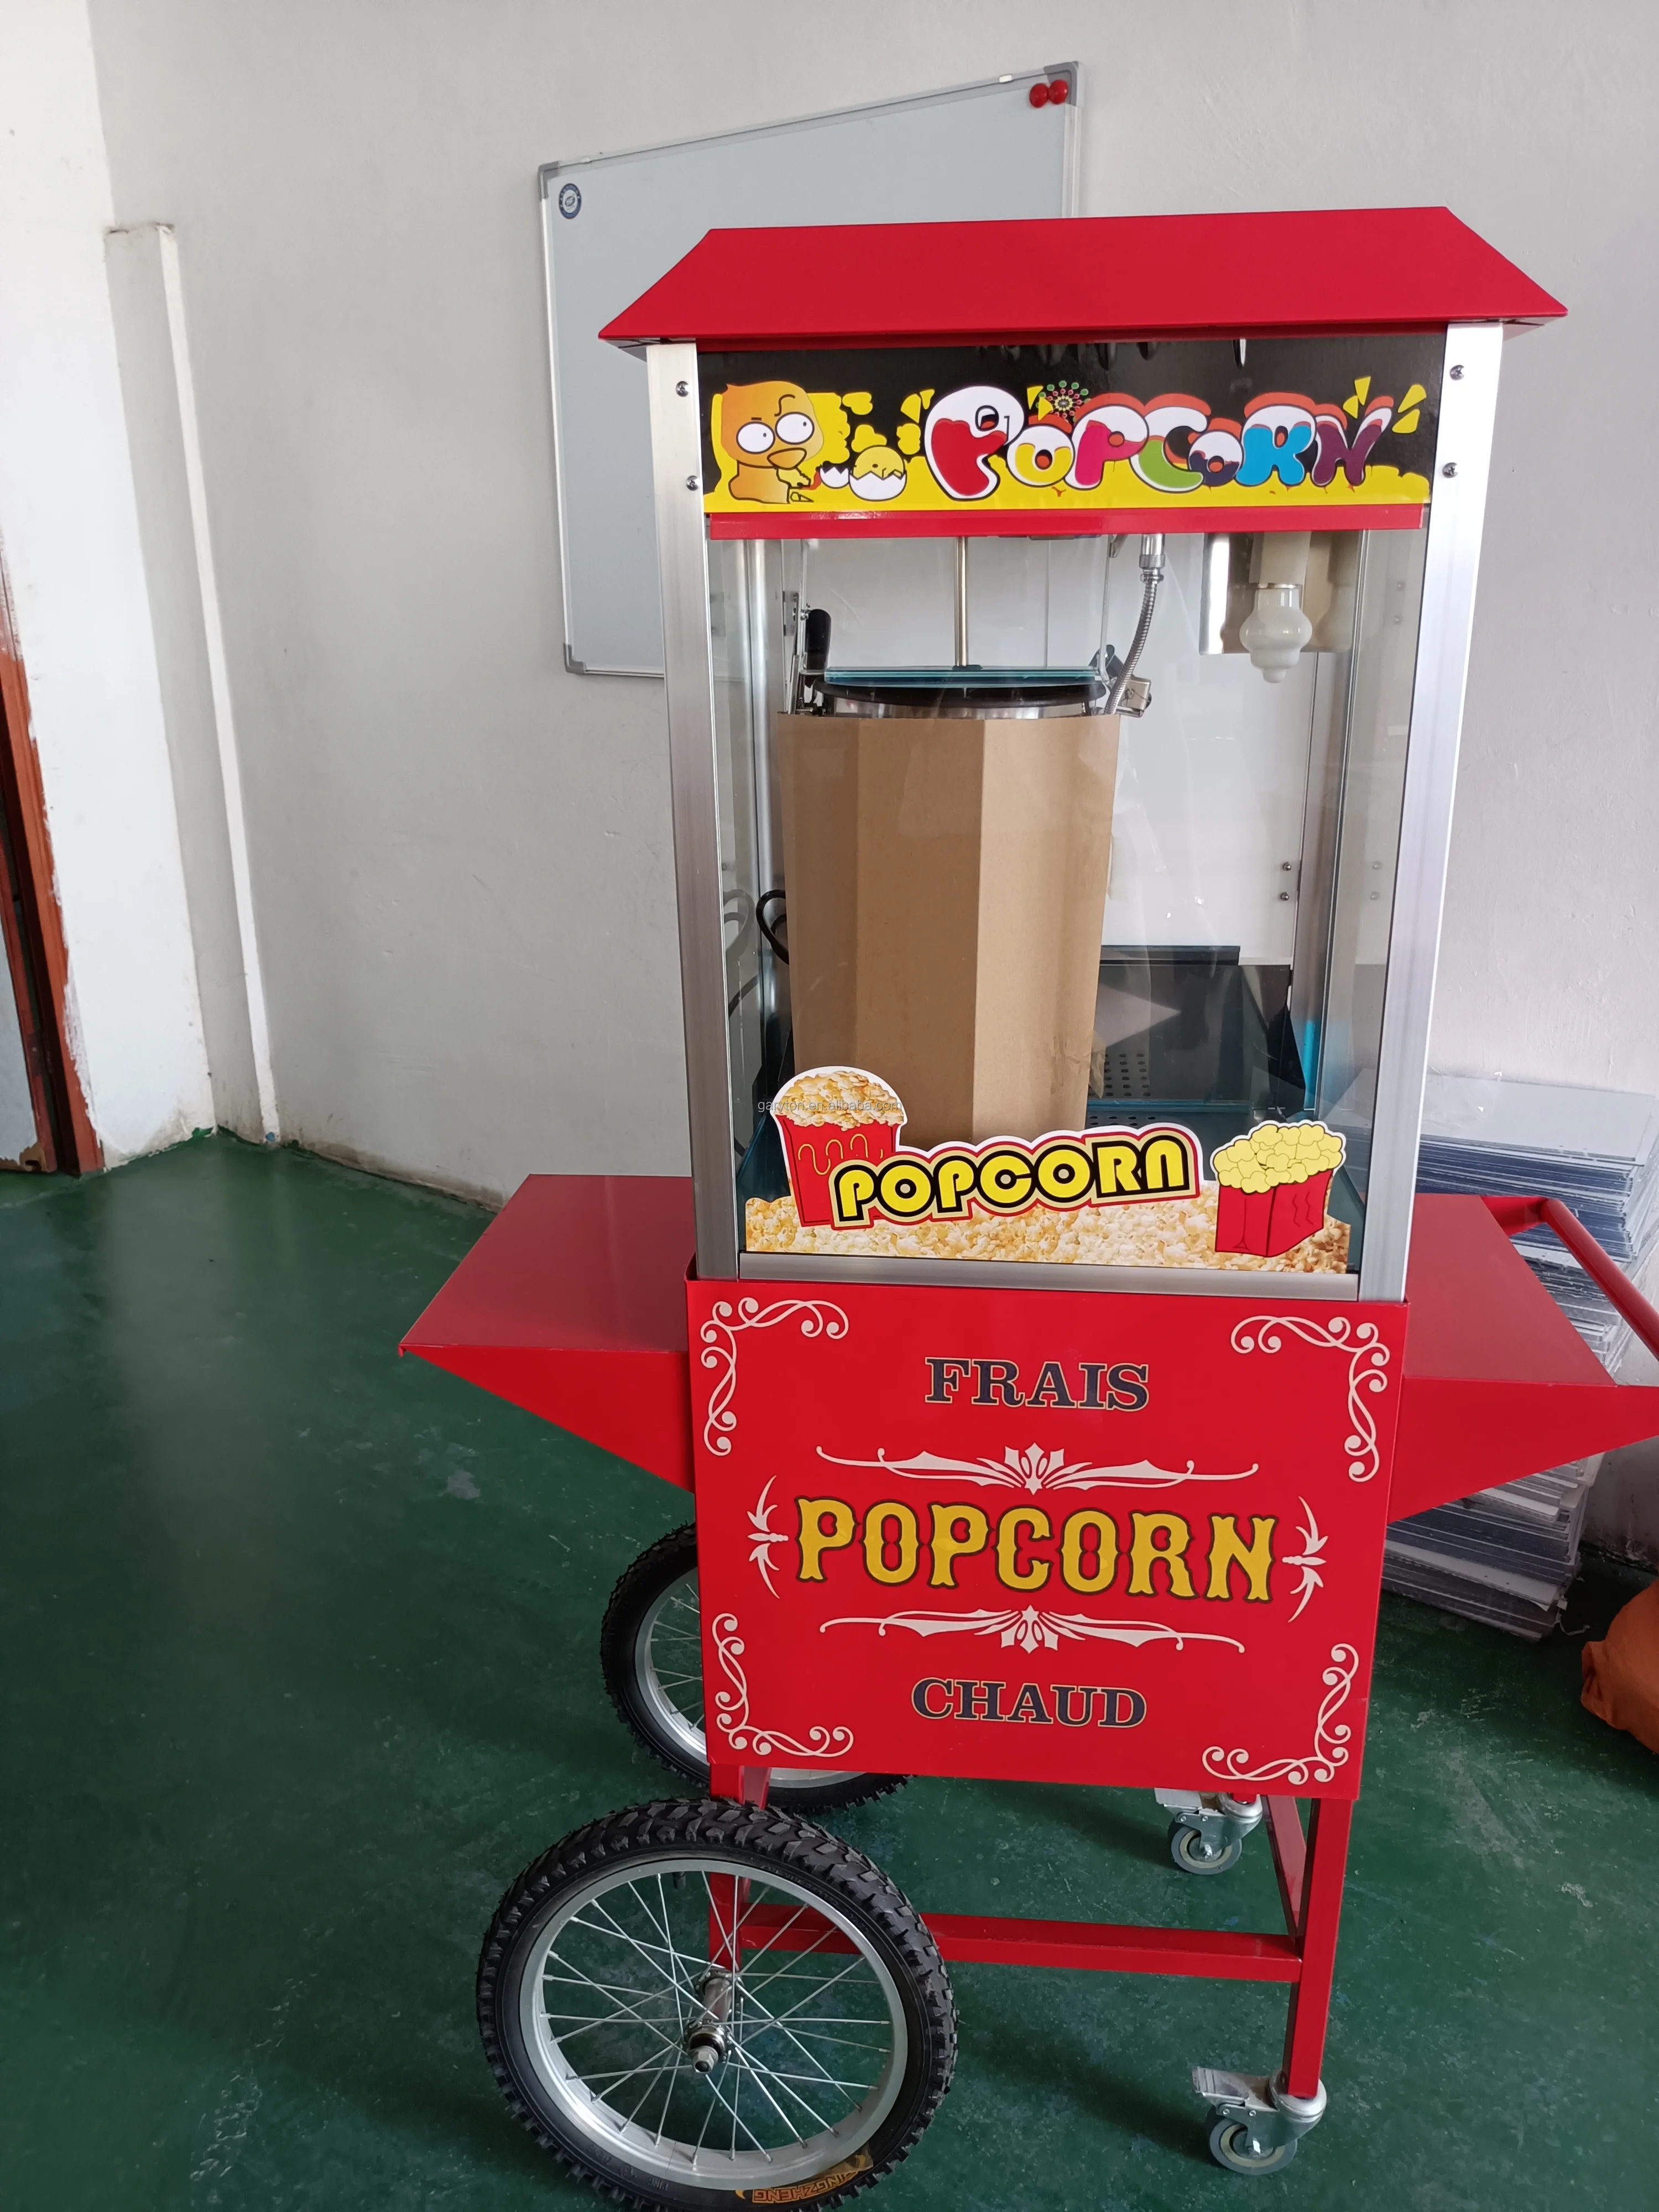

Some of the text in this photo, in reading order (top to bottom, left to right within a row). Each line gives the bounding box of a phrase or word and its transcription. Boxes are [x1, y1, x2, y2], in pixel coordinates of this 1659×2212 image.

[833, 1134, 1191, 1222] POPCORN
[924, 1356, 1149, 1412] FRAIS
[795, 1495, 1279, 1603] POPCORN
[911, 1677, 1147, 1729] CHAUD
